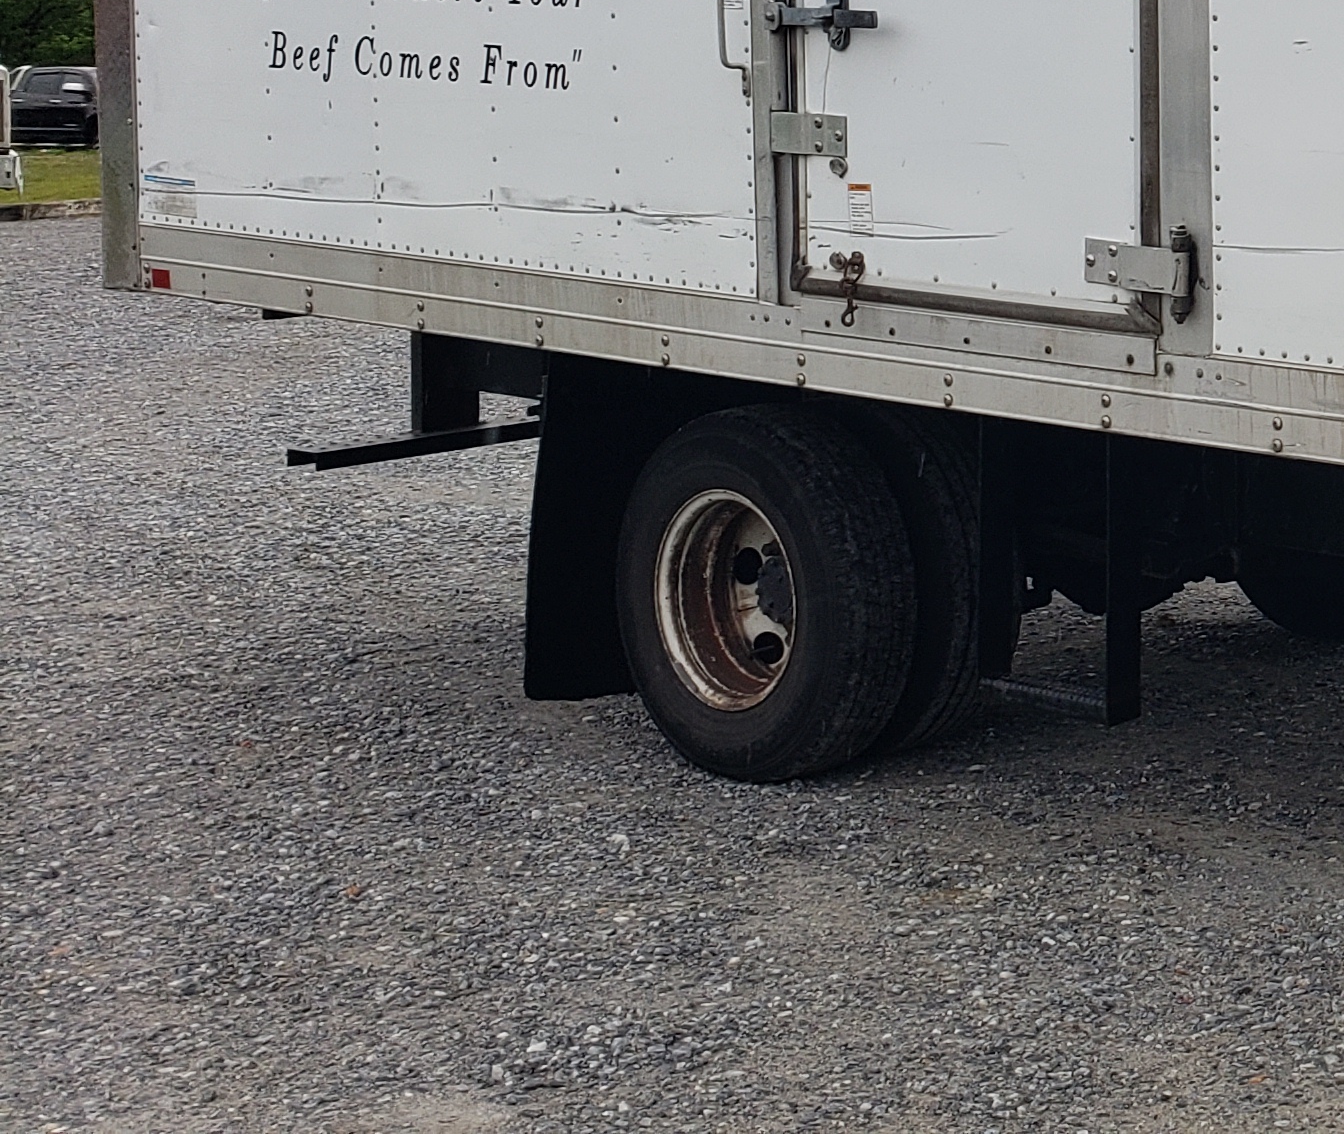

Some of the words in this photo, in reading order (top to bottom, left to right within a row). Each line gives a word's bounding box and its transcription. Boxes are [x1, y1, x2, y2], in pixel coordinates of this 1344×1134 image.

[269, 31, 338, 82] Beef
[354, 36, 460, 82] Comes
[480, 44, 582, 90] From"
